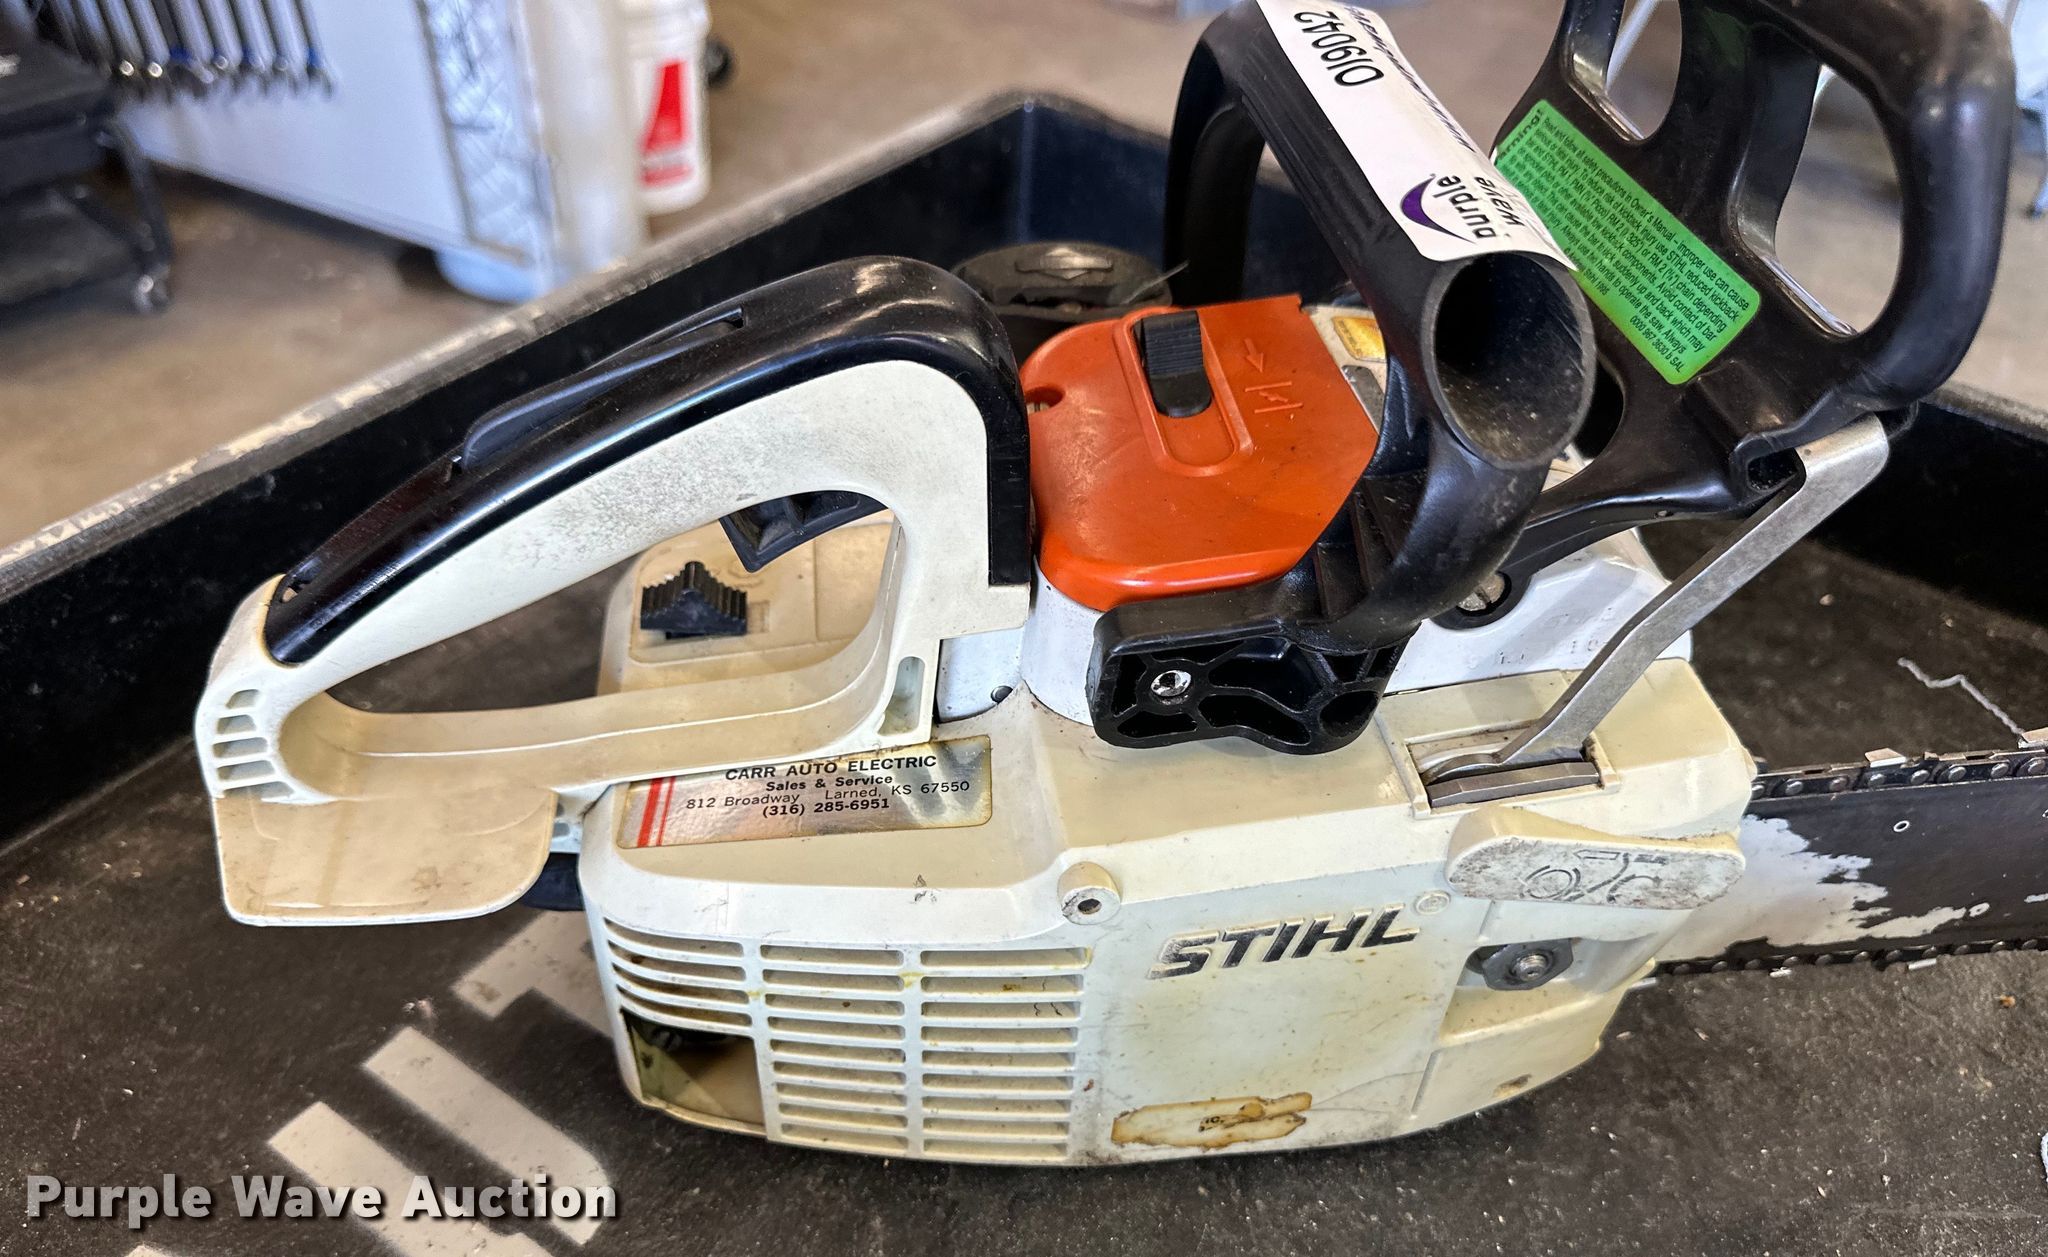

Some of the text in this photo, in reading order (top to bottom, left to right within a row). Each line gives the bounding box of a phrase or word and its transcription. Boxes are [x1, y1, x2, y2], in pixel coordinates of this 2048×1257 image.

[1433, 175, 1497, 239] purple
[1474, 176, 1526, 227] wave
[1594, 166, 1628, 200] precautions
[1628, 197, 1656, 223] Owner's
[1650, 216, 1676, 242] Manual
[1673, 240, 1707, 272] improper
[1701, 265, 1718, 282] use
[1713, 277, 1729, 292] can
[1725, 288, 1750, 311] cause
[1602, 191, 1616, 205] risk
[1617, 205, 1643, 231] kickback
[1637, 225, 1658, 247] injury
[1654, 241, 1668, 255] use
[1665, 250, 1689, 273] STIHL
[1683, 267, 1713, 296] reduced
[1708, 290, 1741, 322] kickback
[1606, 212, 1620, 227] RM
[1647, 252, 1663, 268] RM
[1675, 278, 1697, 300] chain
[1689, 294, 1729, 334] depending
[1559, 224, 1581, 248] Always
[1577, 242, 1590, 256] use
[1595, 258, 1616, 281] hands
[1616, 282, 1643, 311] operate
[1639, 303, 1653, 319] the
[1649, 315, 1664, 332] saw.
[1660, 327, 1688, 357] Always
[1587, 232, 1600, 246] bar
[1601, 246, 1616, 262] kick
[1611, 257, 1641, 289] suddenly
[1644, 288, 1660, 306] and
[1655, 300, 1674, 320] back
[1669, 314, 1692, 338] which
[1684, 334, 1704, 355] may
[1620, 246, 1660, 288] components.
[1655, 280, 1678, 303] Avoid
[1672, 296, 1700, 324] contact
[1701, 325, 1718, 342] bar
[1641, 326, 1656, 342] 967
[1669, 355, 1685, 373] SAL
[686, 780, 970, 809] 812 Broadway Larned, KS 67550
[725, 755, 937, 781] CARR AUTO ELECTRIC
[766, 774, 893, 792] Sales & Service
[762, 798, 890, 818] (316) 285-6951
[1148, 904, 1421, 980] STIHL
